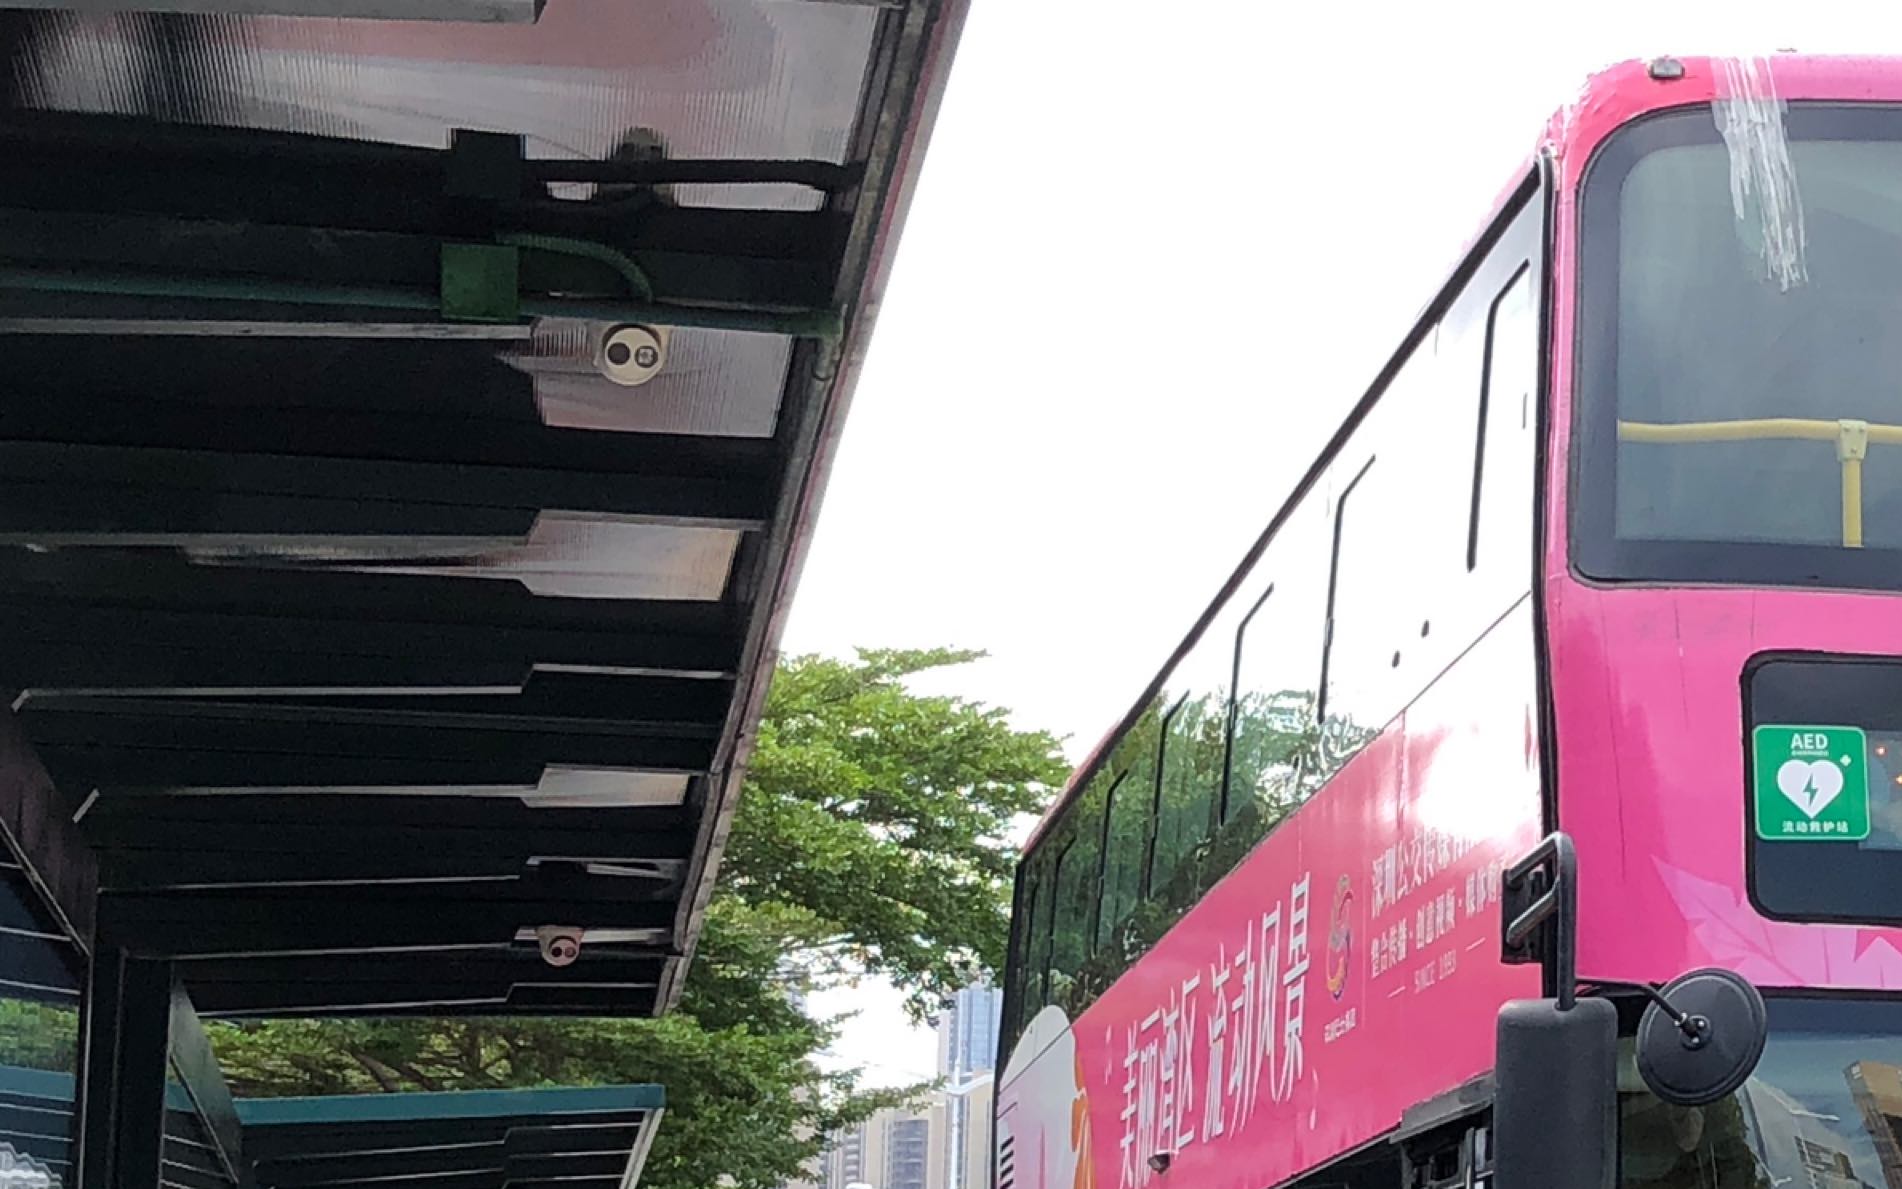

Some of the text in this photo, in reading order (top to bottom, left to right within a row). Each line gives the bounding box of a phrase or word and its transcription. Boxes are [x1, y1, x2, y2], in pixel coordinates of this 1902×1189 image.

[1790, 733, 1828, 750] AED
[1202, 871, 1311, 1143] 流动风景
